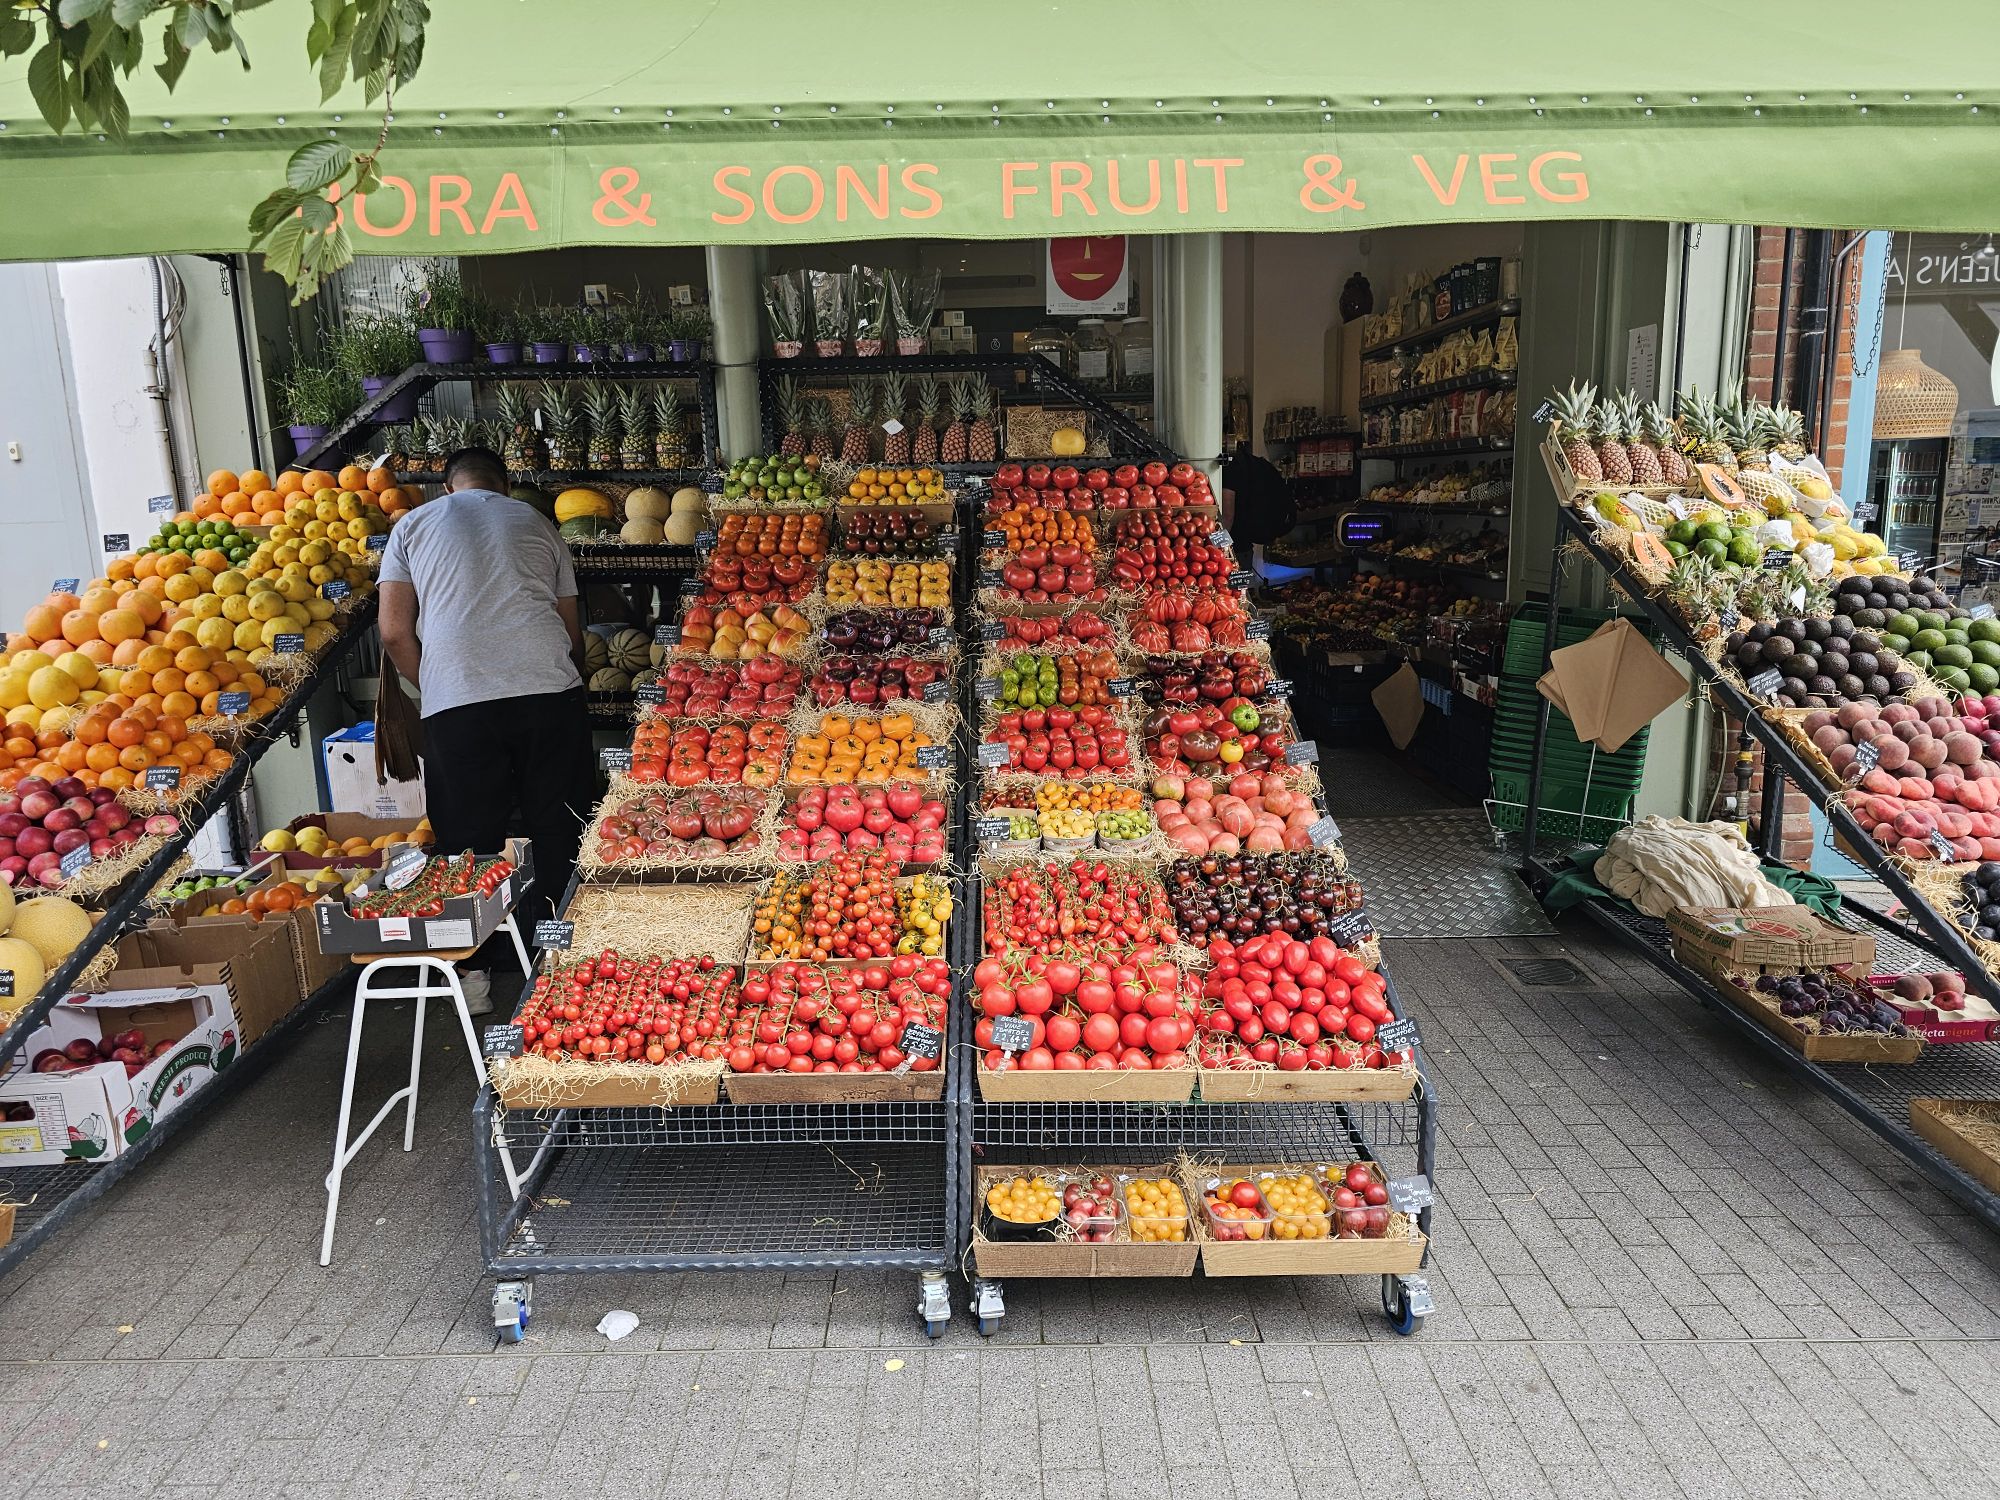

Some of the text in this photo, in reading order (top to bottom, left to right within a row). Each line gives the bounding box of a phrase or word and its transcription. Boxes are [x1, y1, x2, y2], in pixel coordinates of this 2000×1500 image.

[590, 165, 657, 228] &
[710, 162, 944, 226] SONS
[1002, 157, 1245, 219] FRUIT
[1298, 153, 1366, 213] &
[1411, 151, 1591, 206] VEG
[493, 1024, 514, 1032] DUTCH
[994, 1026, 1030, 1037] TOMATOES
[1003, 1022, 1023, 1030] VINE
[1395, 1020, 1415, 1032] VINE
[1383, 1027, 1416, 1042] TOMATOES
[1919, 1028, 1977, 1038] ectavigne
[485, 1034, 519, 1044] TOMATOES
[1383, 1037, 1407, 1050] £3.30
[153, 1050, 209, 1101] FRESH PRODUCE
